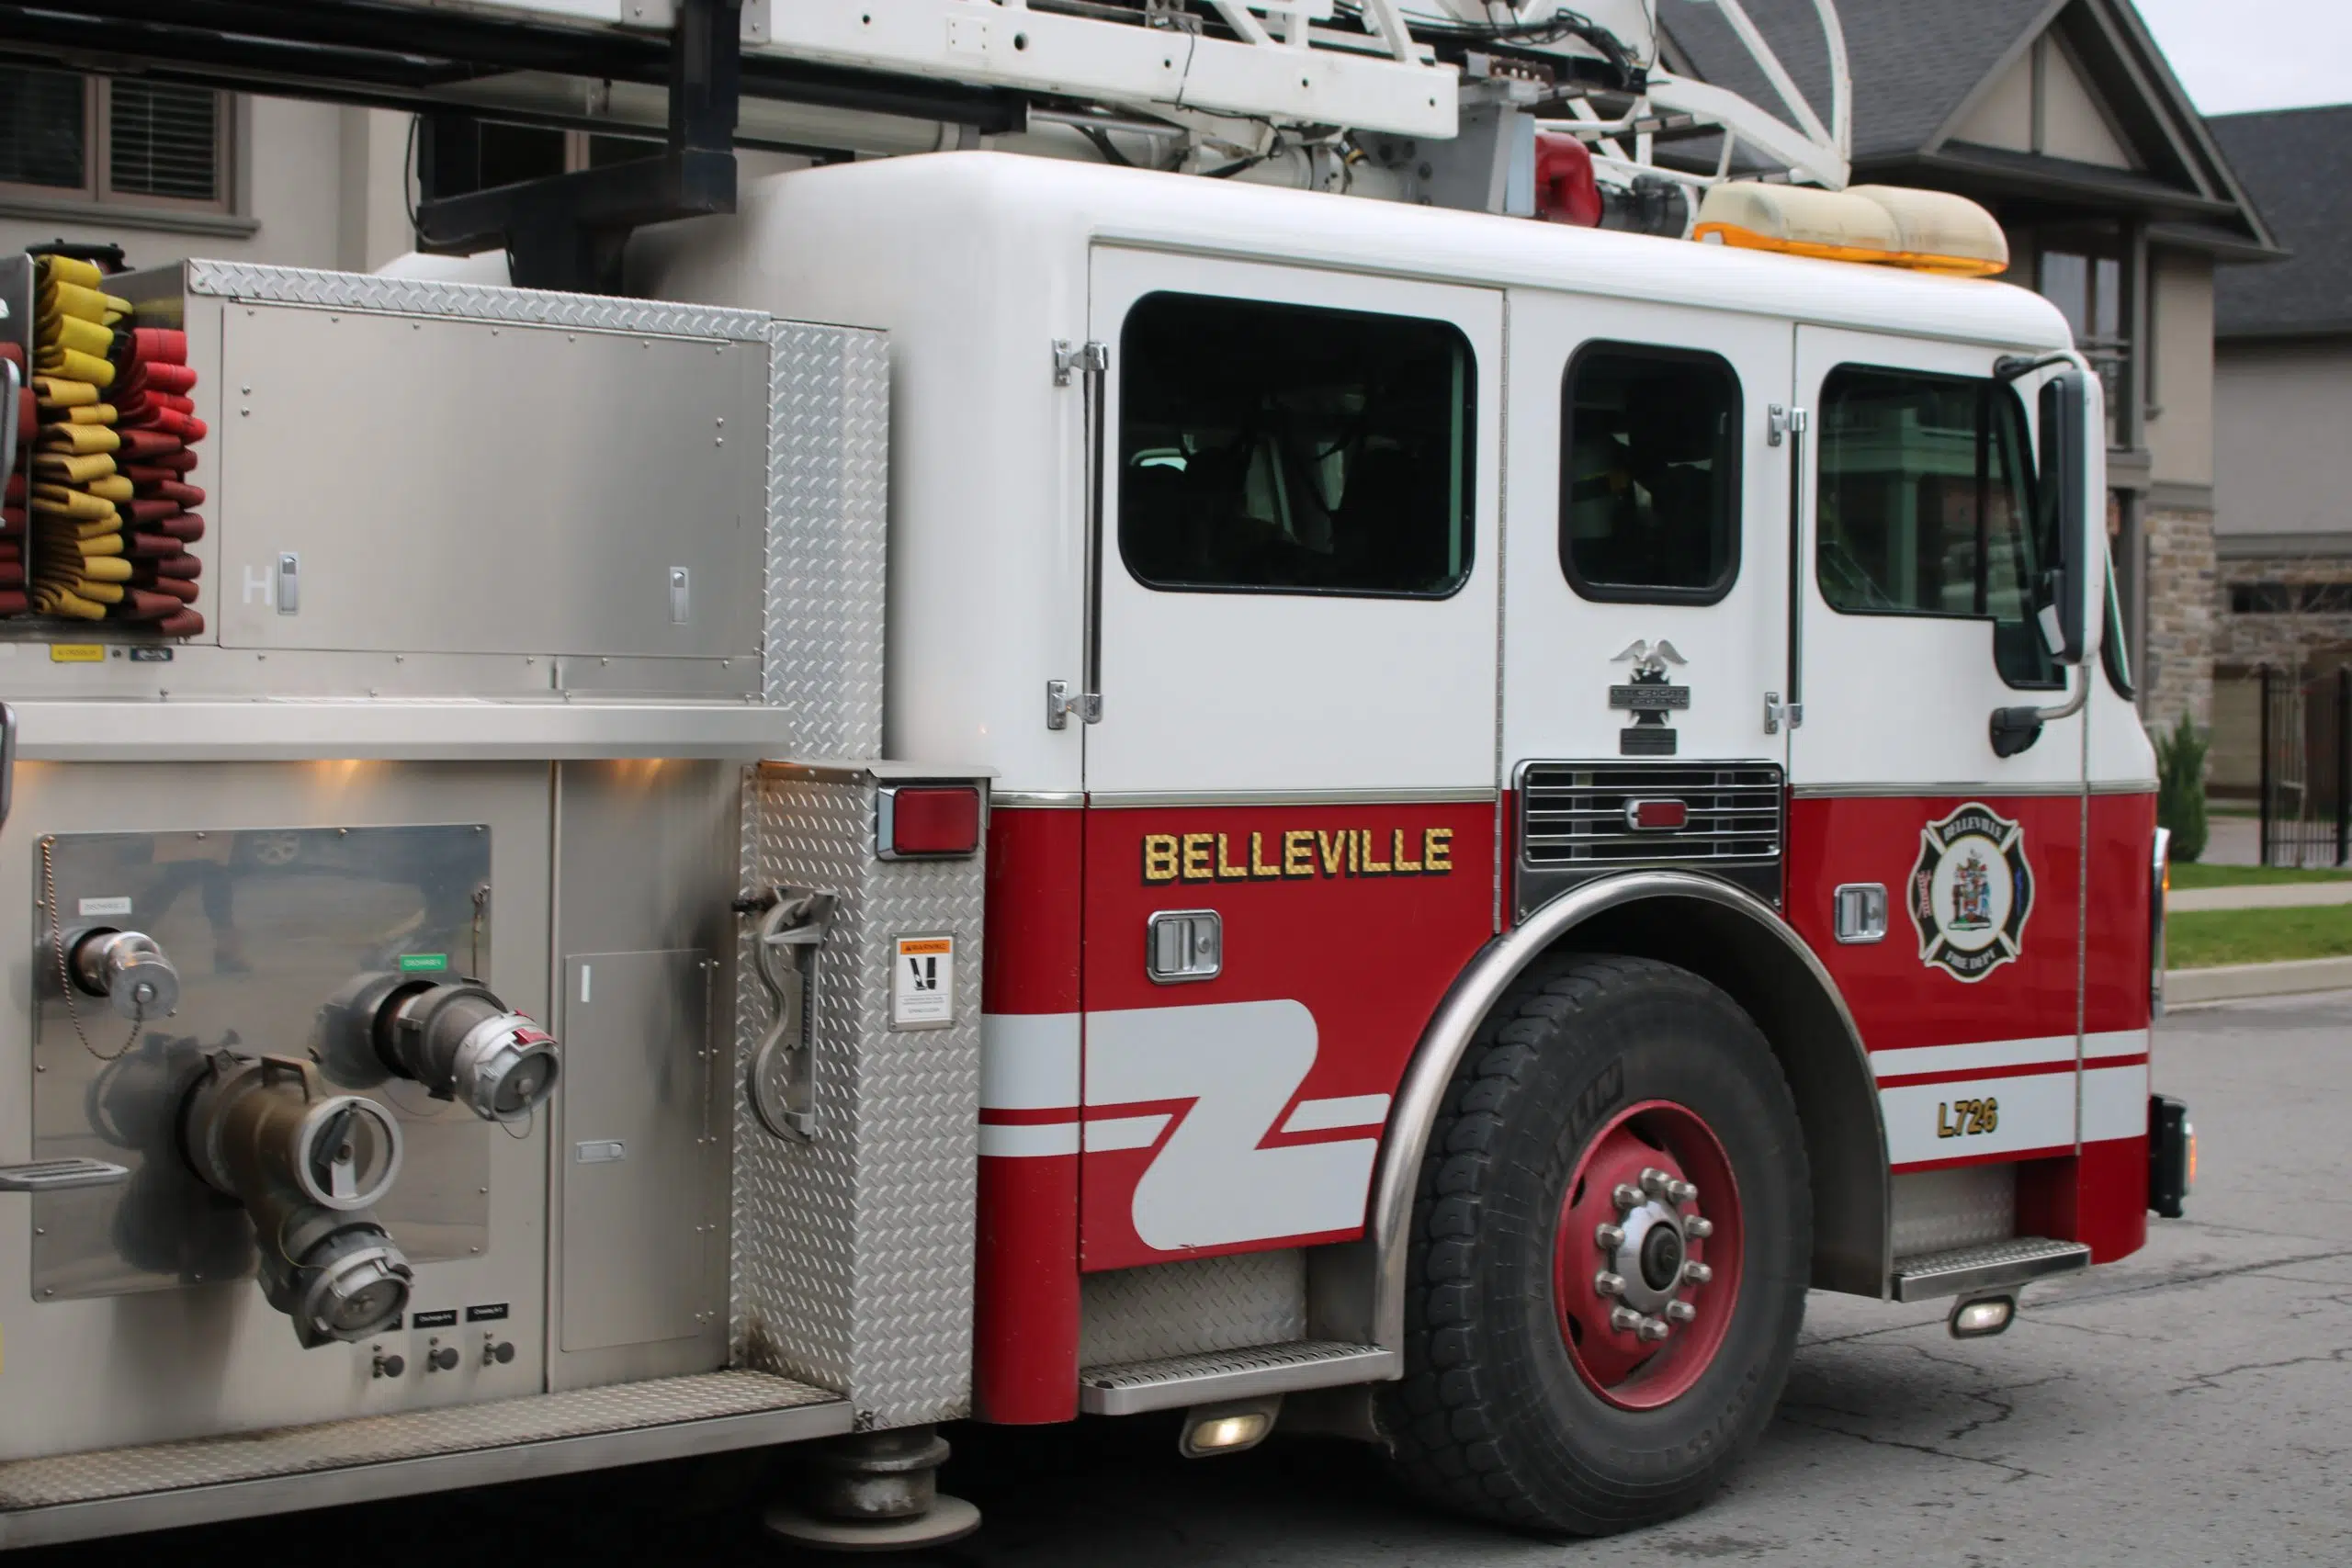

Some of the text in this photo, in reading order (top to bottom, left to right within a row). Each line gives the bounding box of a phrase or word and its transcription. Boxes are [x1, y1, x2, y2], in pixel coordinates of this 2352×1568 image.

[243, 565, 273, 604] H
[1942, 816, 2004, 841] BELLEVILLE
[1142, 828, 1453, 883] BELLEVILLE
[1944, 949, 1996, 970] FIRE DEPT
[1937, 1097, 1998, 1139] L726
